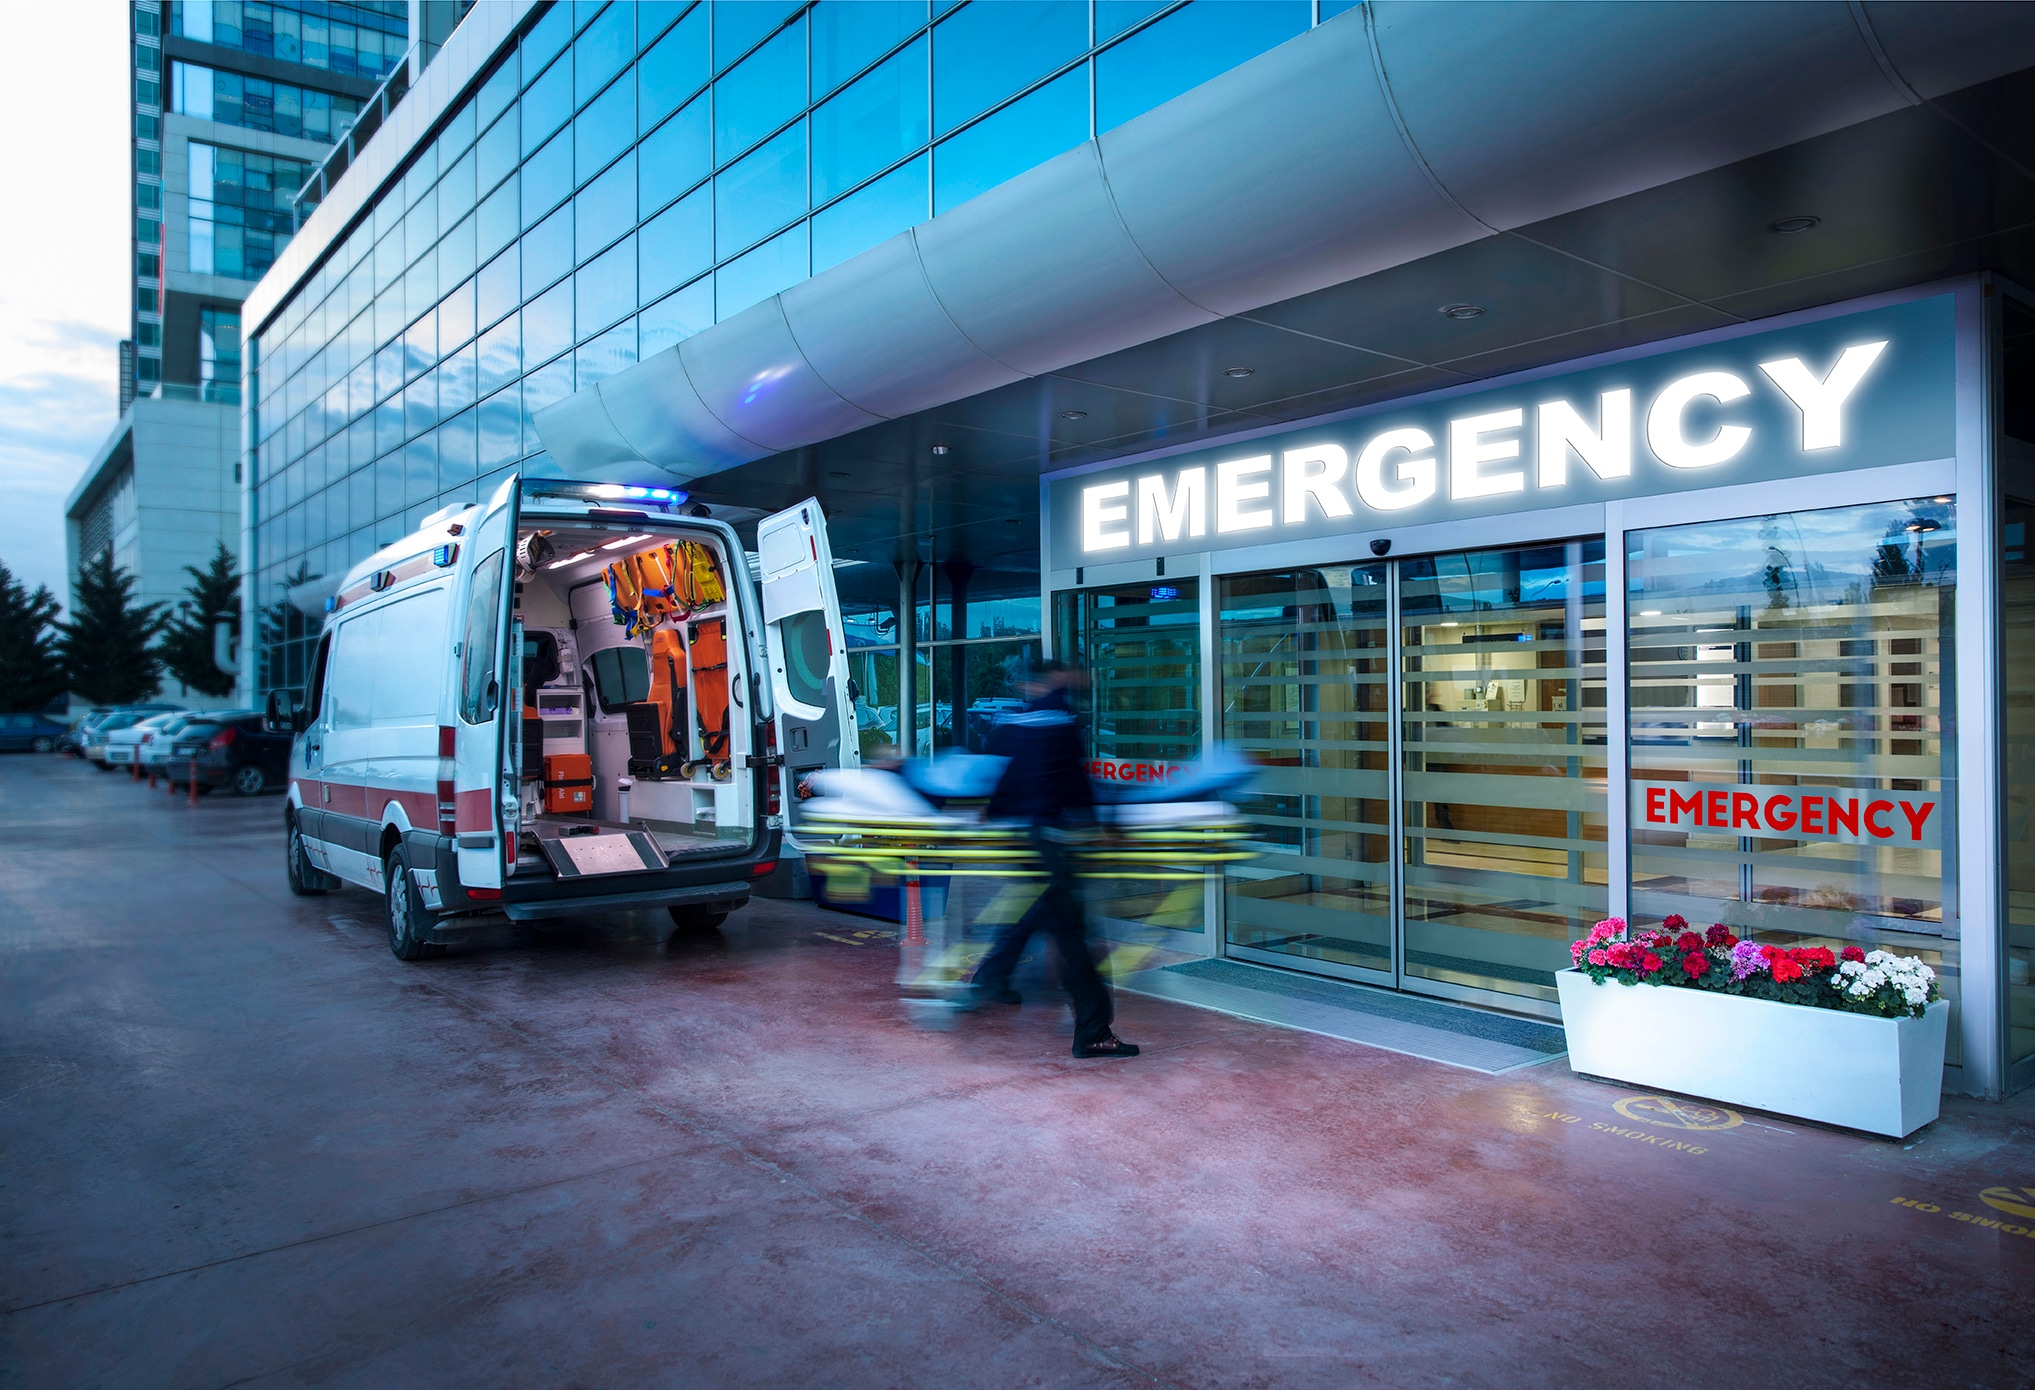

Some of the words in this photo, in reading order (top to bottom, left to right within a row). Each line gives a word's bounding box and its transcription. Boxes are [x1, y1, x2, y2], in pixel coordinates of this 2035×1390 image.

[1082, 340, 1888, 553] EMERGENCY
[1082, 761, 1199, 784] ERGENCY
[1646, 787, 1936, 841] EMERGENCY
[1543, 1111, 1582, 1124] NO
[1588, 1121, 1709, 1155] SMOKING
[1890, 1196, 1941, 1213] NO
